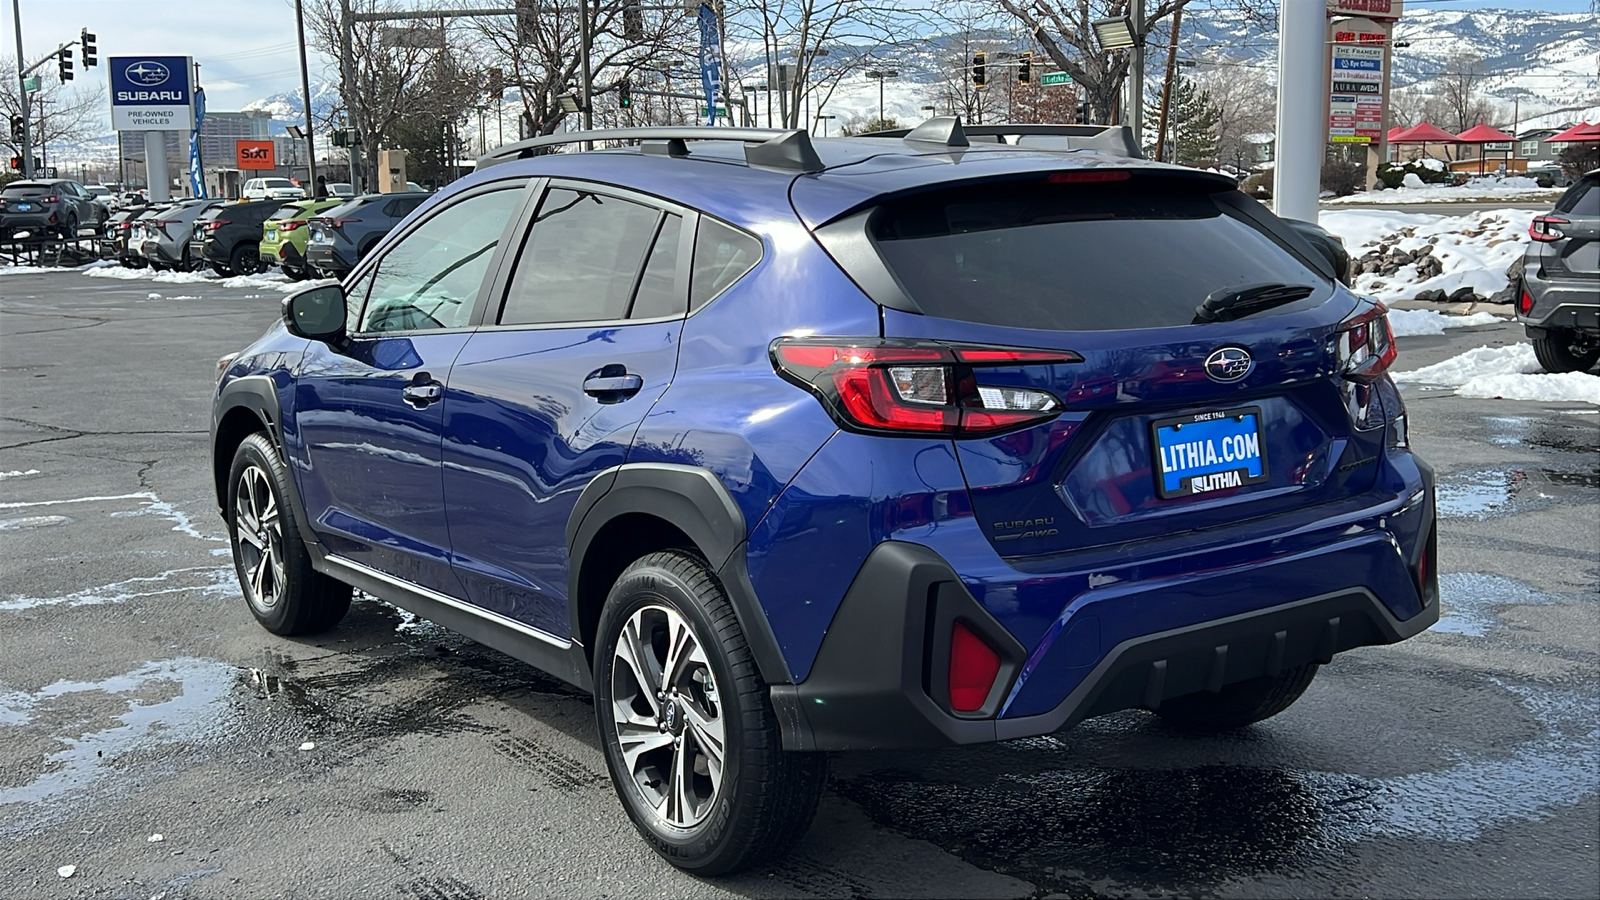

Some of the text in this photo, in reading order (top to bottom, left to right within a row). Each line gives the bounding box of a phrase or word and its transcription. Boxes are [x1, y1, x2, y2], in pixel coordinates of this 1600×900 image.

[1350, 60, 1375, 68] Eye Clinic
[1334, 83, 1356, 92] AURA
[1360, 84, 1378, 92] AVEDA
[117, 91, 182, 101] SUBARU
[1194, 413, 1212, 422] SINCE
[1160, 432, 1260, 473] LITHIA.COM
[1203, 470, 1242, 492] LITHIA
[993, 517, 1054, 530] SUBARU
[1020, 528, 1059, 539] AWD
